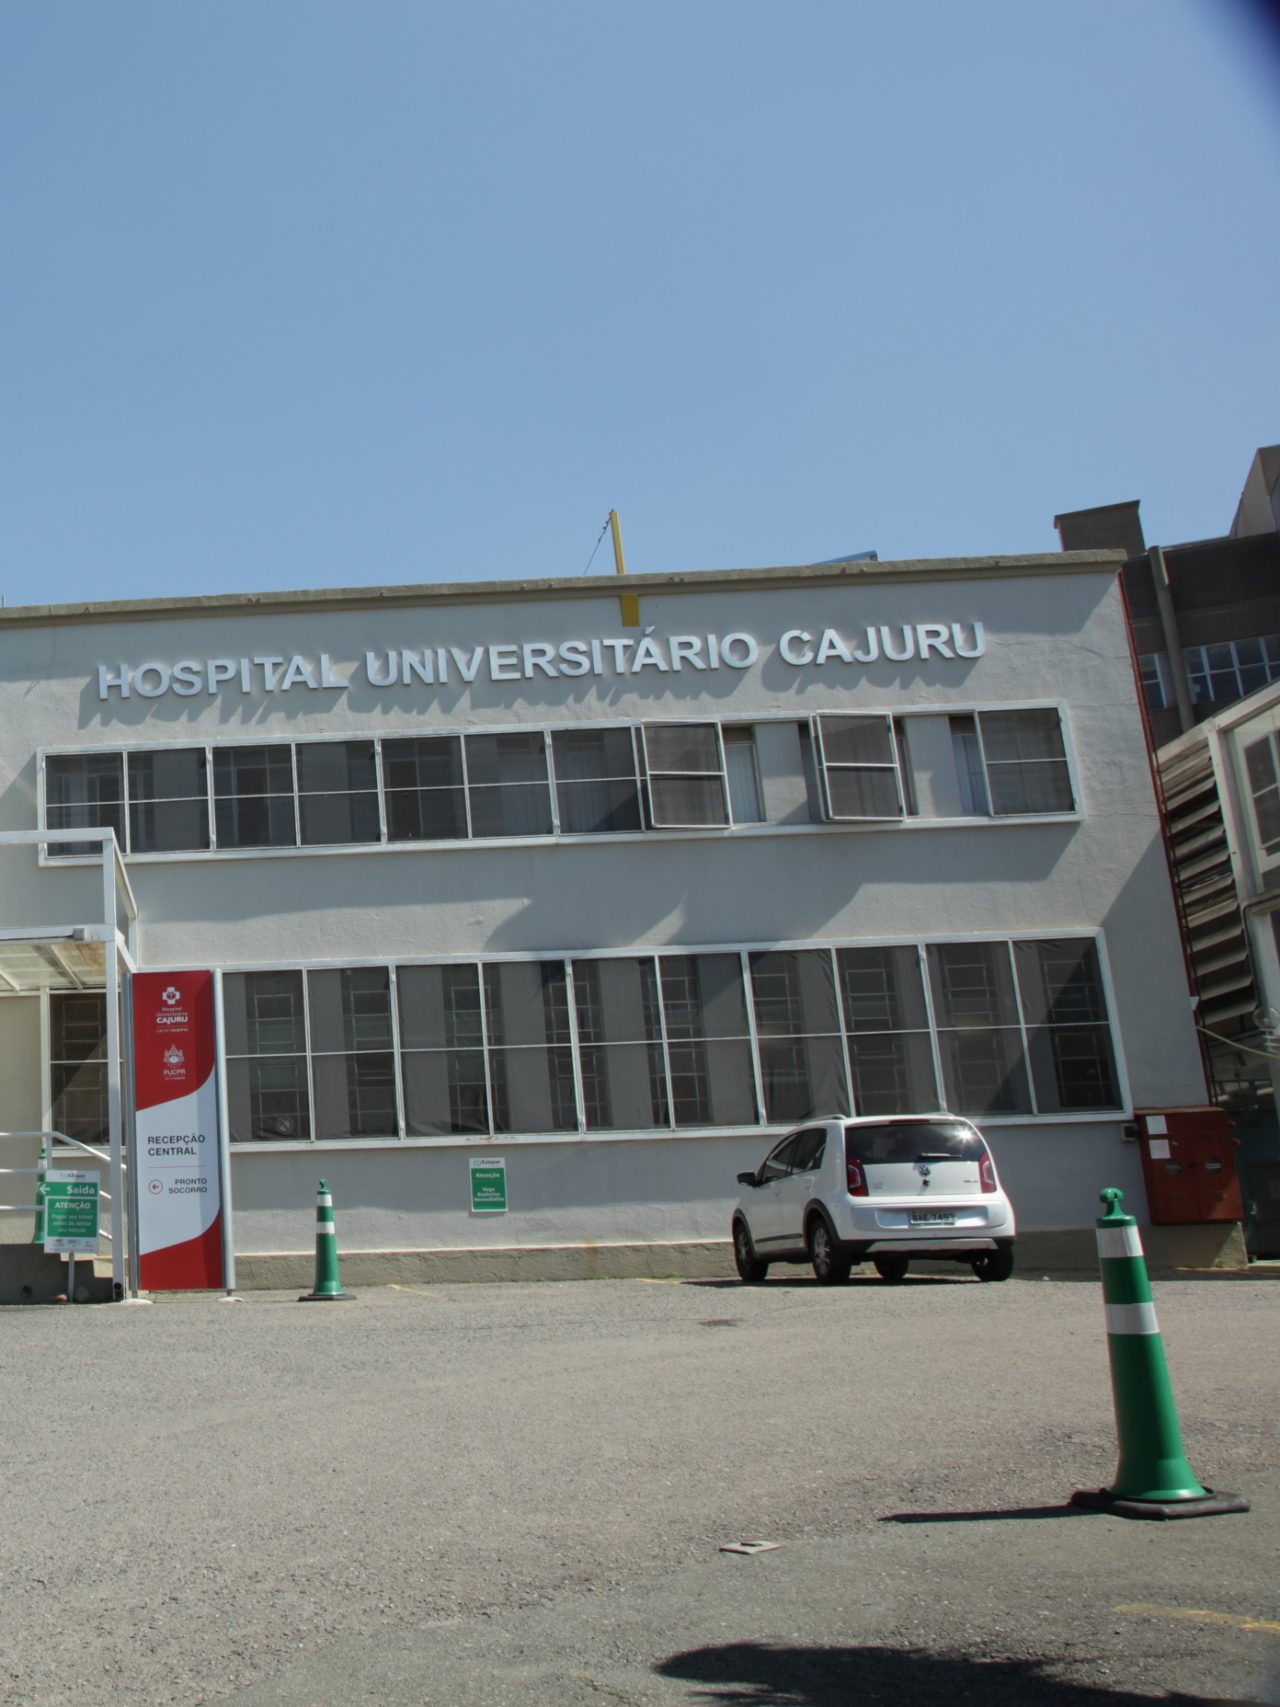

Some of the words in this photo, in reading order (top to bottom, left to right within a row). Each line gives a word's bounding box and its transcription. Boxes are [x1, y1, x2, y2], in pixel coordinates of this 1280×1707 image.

[97, 653, 350, 701] HOSPITAL
[365, 625, 759, 688] UNIVERSITÁRIO
[779, 621, 987, 667] CAJURU
[156, 1016, 188, 1024] CAJURU
[147, 1132, 206, 1145] RECEPÇÃO
[147, 1147, 197, 1156] CENTRAL
[66, 1184, 95, 1194] Saída
[168, 1186, 208, 1194] SOCORRO
[55, 1201, 91, 1210] ATENÇÃO
